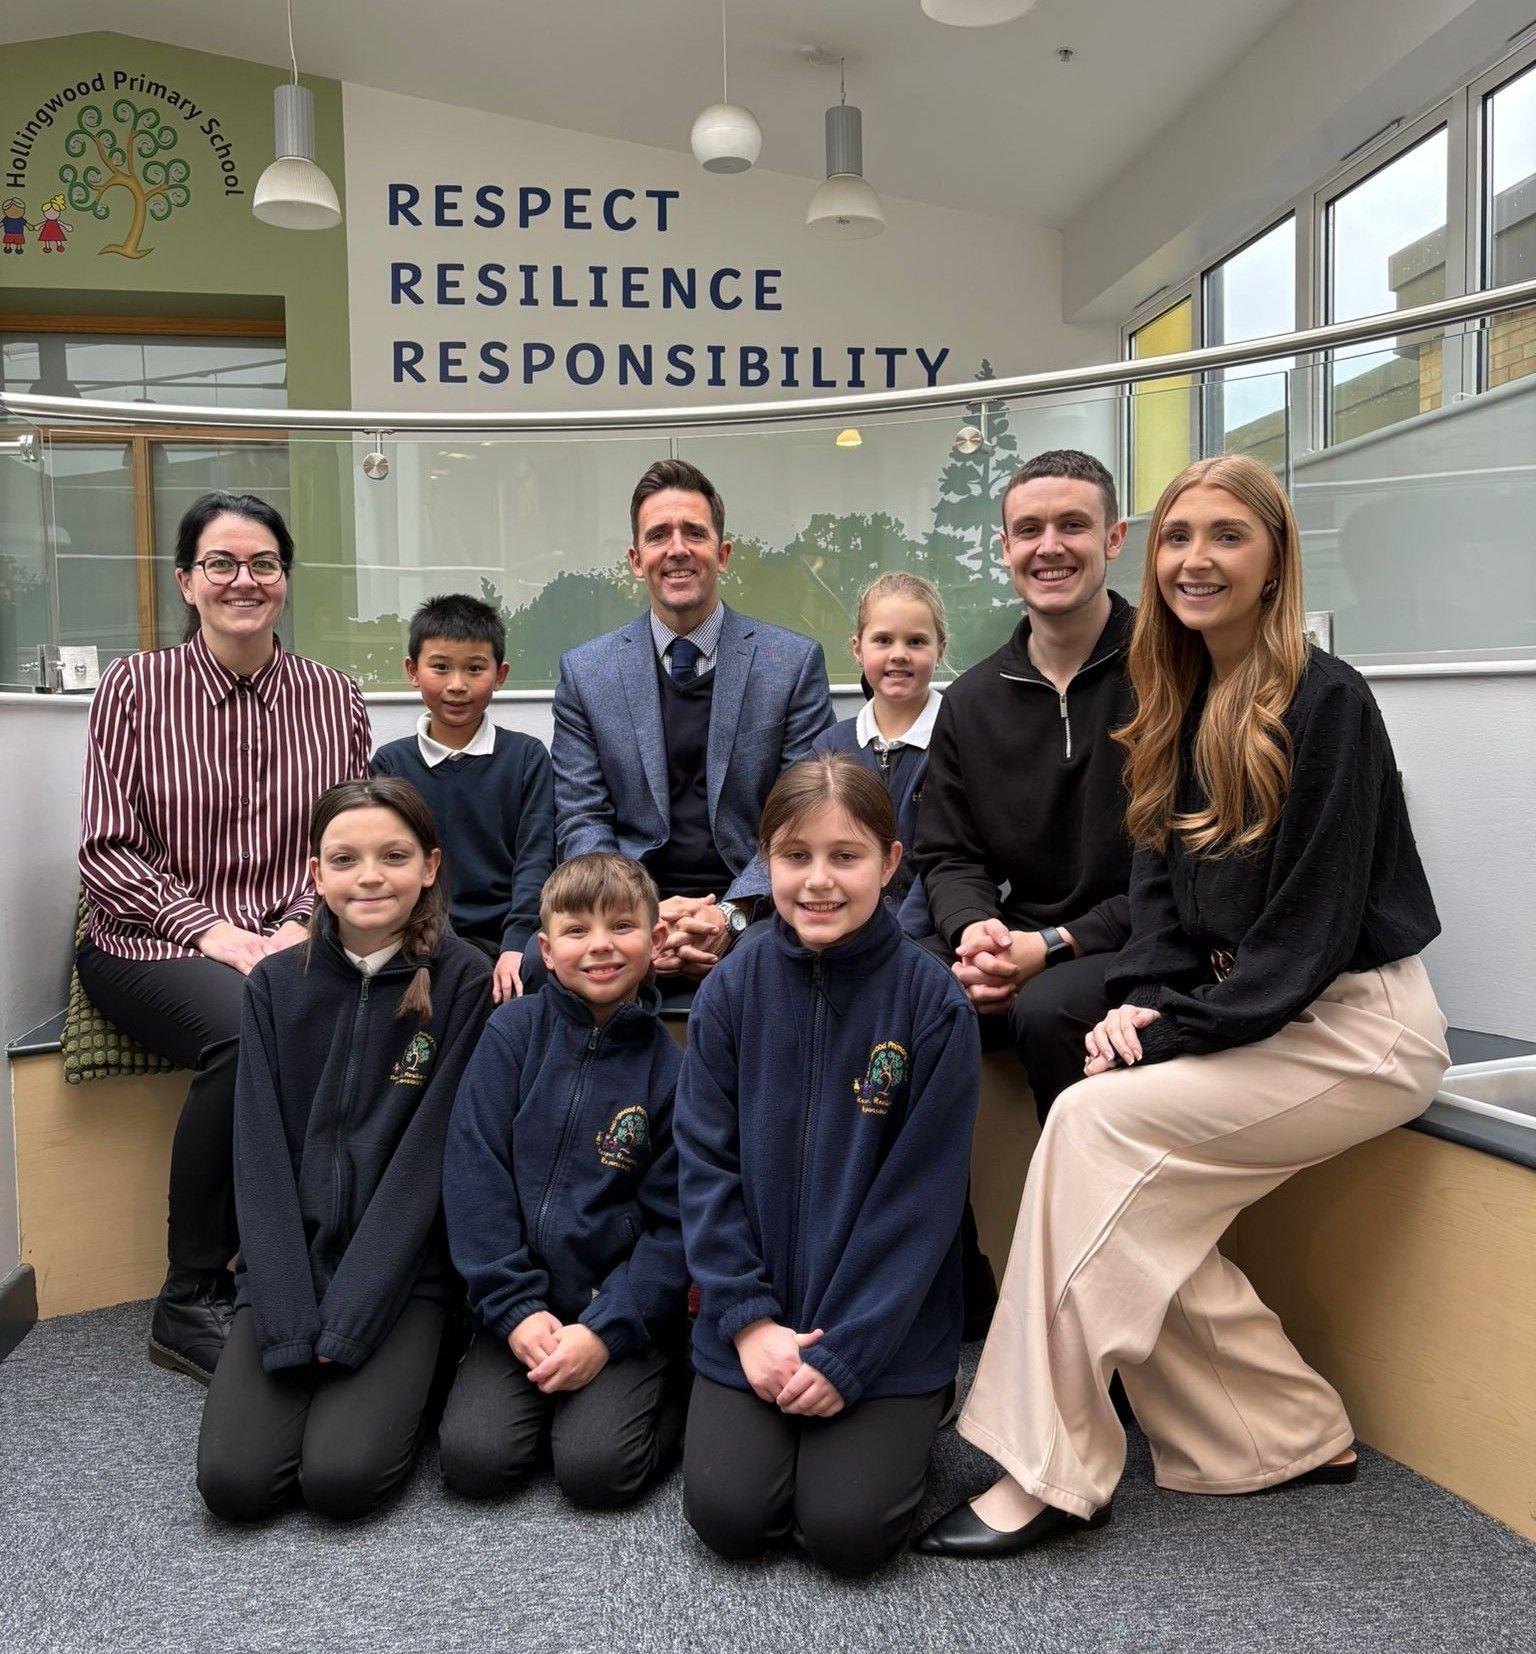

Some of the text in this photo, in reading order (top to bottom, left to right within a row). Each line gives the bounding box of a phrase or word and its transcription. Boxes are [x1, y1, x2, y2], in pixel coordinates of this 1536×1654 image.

[6, 70, 245, 196] Hollingwood Primary School
[388, 183, 680, 232] RESPECT
[390, 262, 783, 311] RESILIENCE
[393, 340, 950, 388] RESPONSIBILITY
